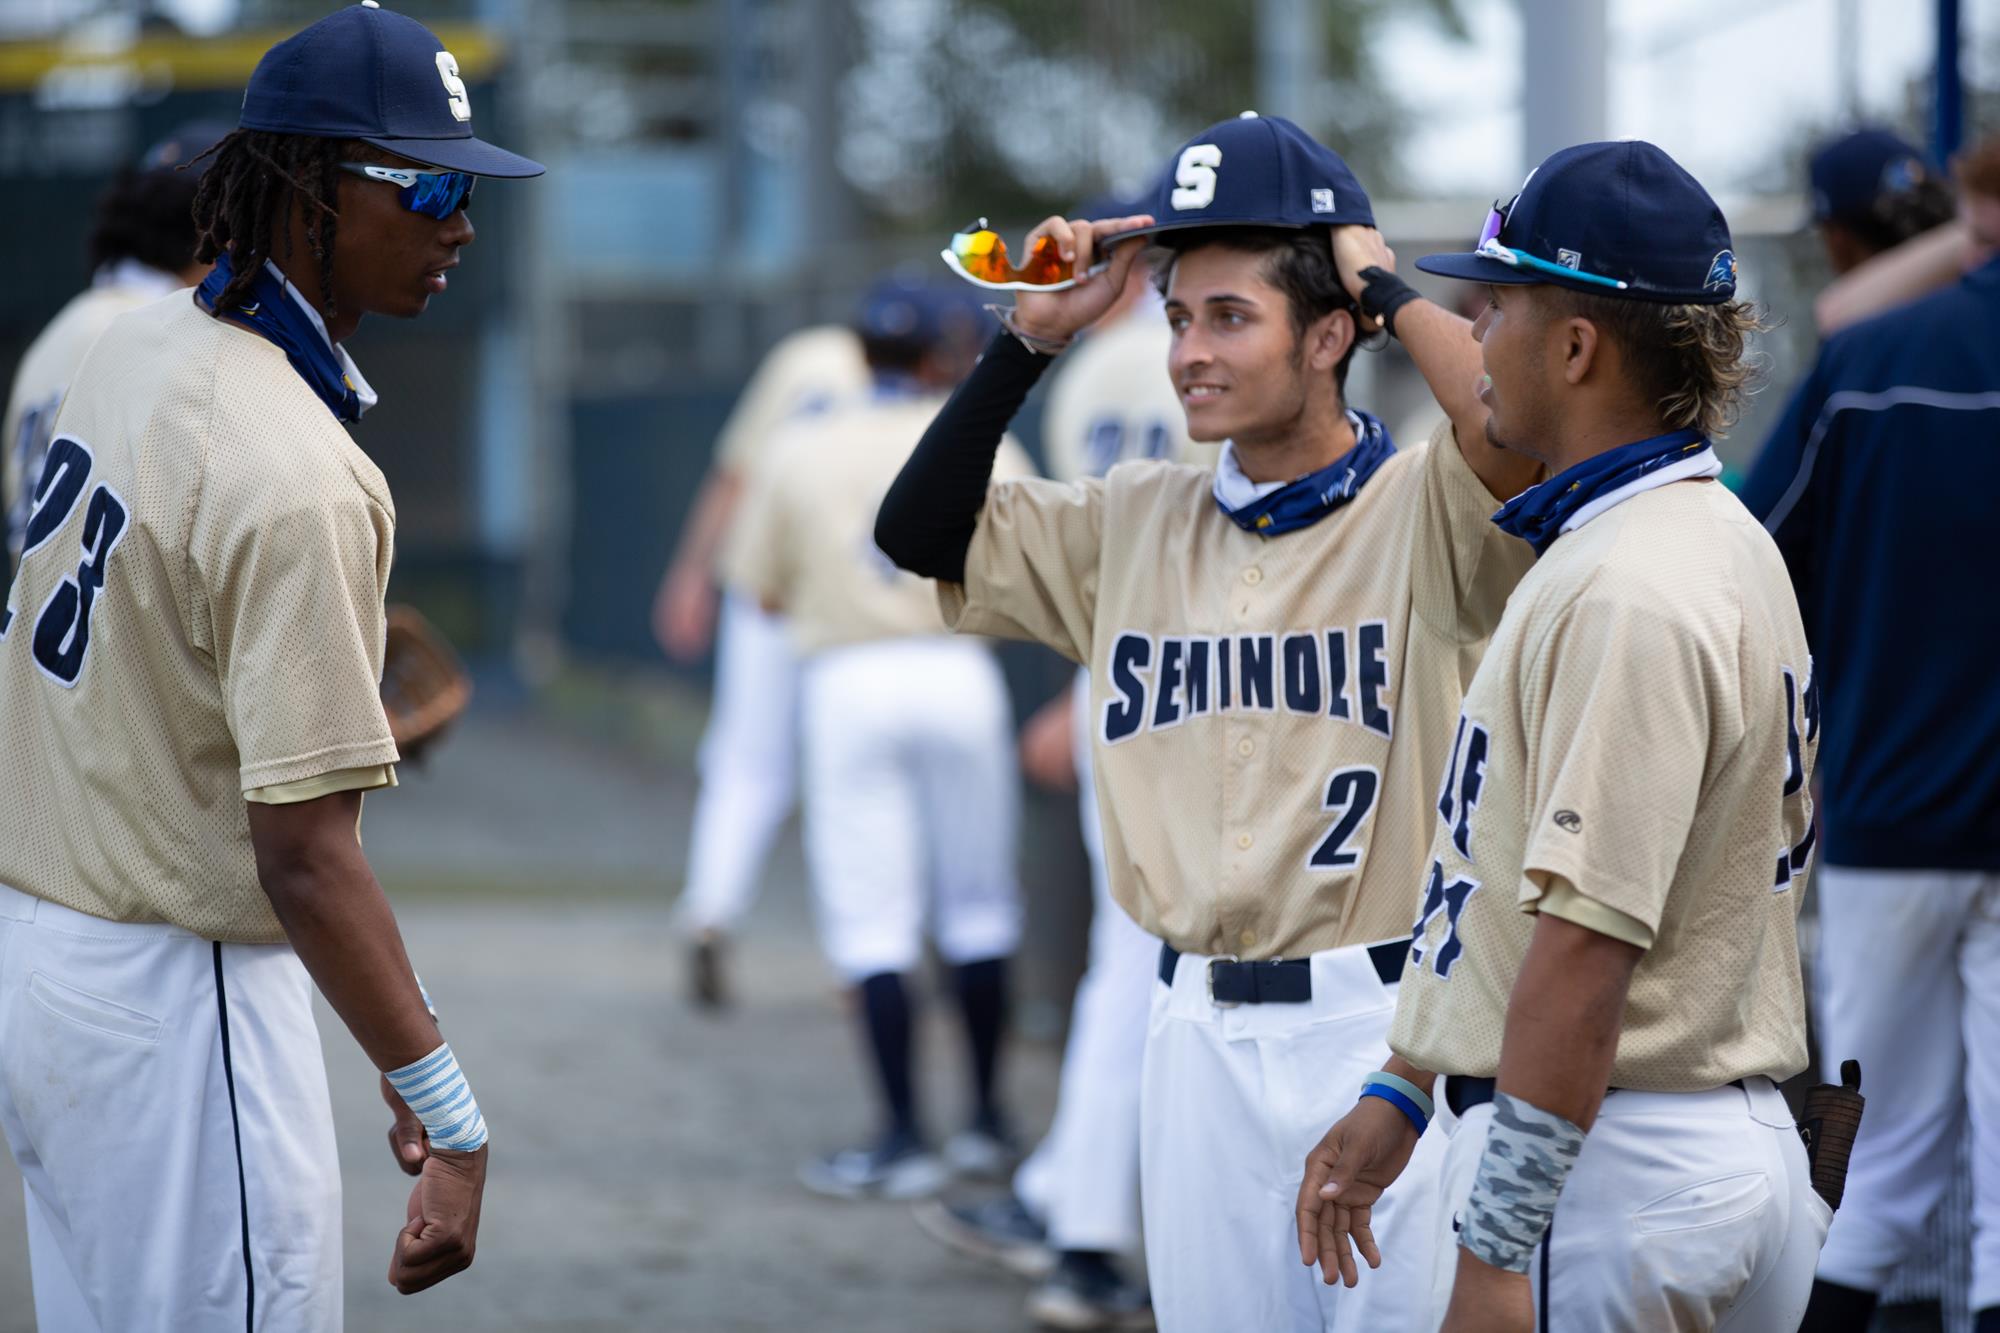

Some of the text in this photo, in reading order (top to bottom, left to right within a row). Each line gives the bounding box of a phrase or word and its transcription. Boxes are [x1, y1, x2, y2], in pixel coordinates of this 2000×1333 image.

[435, 51, 472, 122] S
[1171, 144, 1223, 210] S
[1100, 619, 1393, 746] SEMINOLE
[1306, 764, 1381, 872] 2
